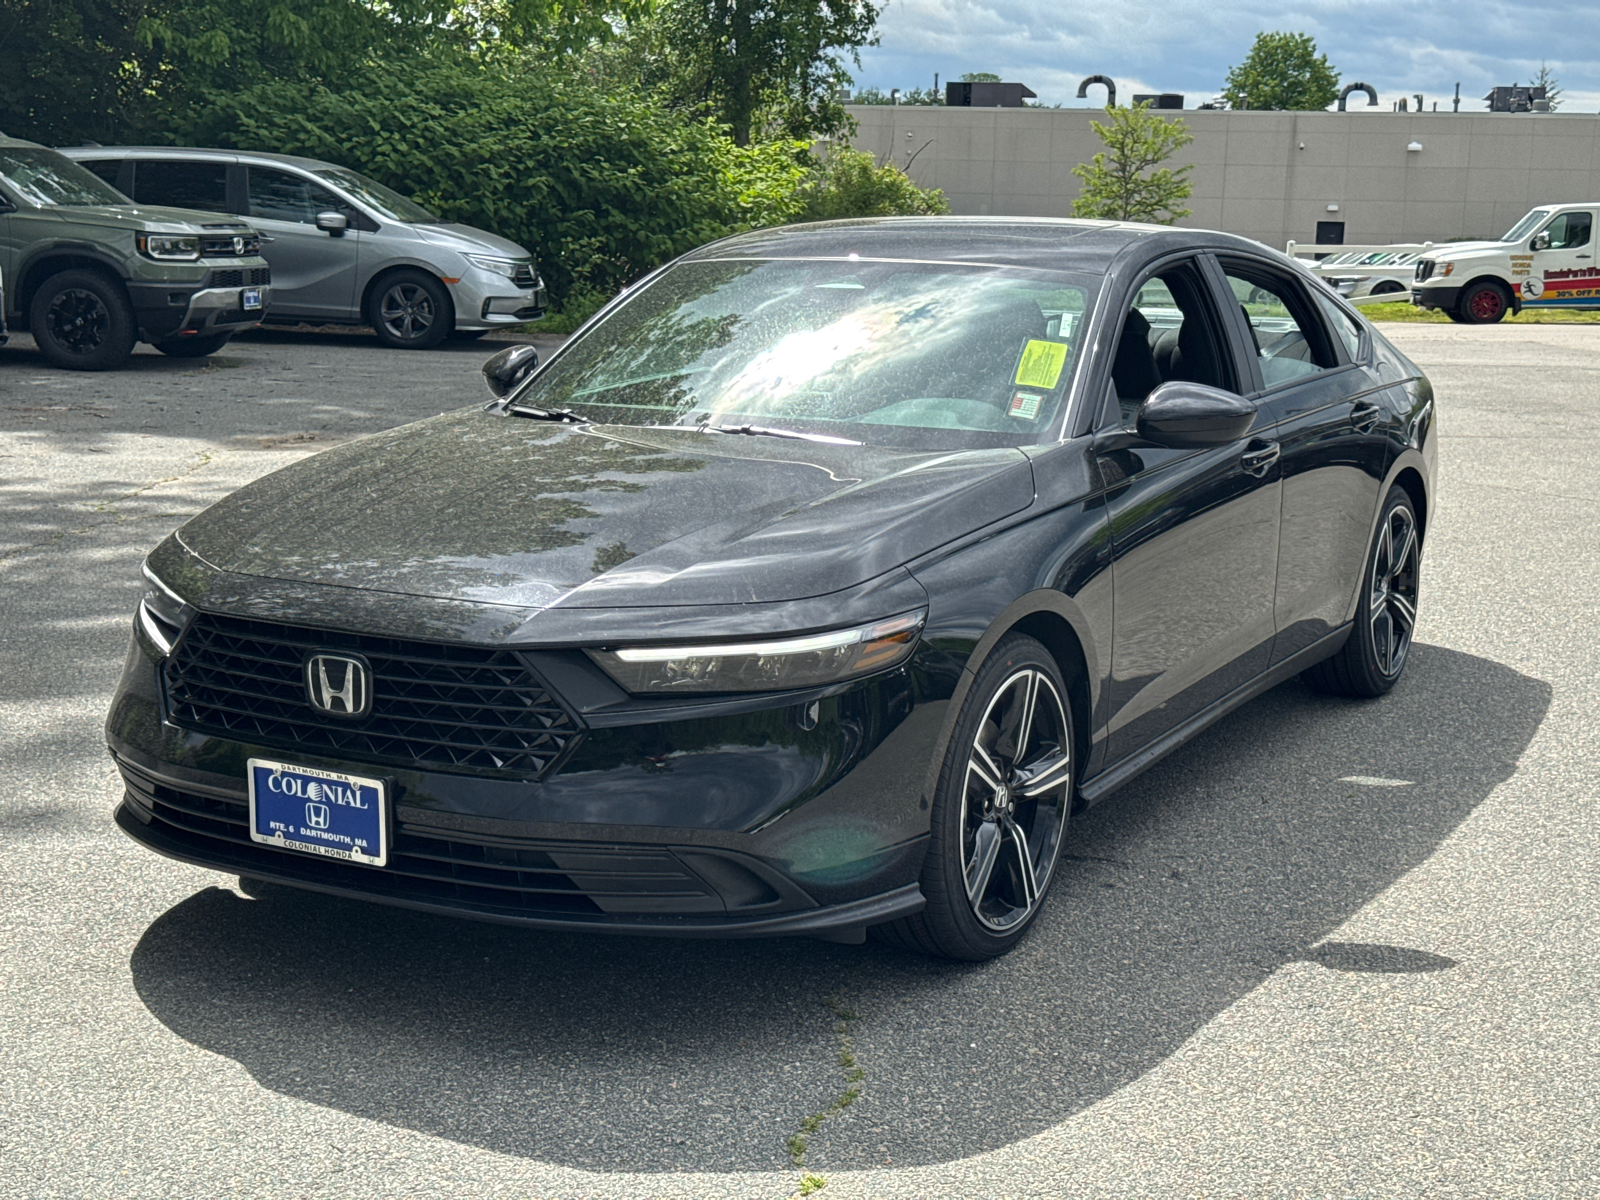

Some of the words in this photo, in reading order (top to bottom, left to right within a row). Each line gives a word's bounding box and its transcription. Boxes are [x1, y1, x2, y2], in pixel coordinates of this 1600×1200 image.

[1576, 289, 1593, 297] OFF
[336, 774, 350, 782] MA
[268, 774, 368, 809] COLONIAL
[269, 821, 288, 832] RTE.
[288, 825, 295, 833] 6
[300, 827, 353, 845] DARTMOUTH,
[354, 838, 368, 848] MA
[283, 840, 322, 854] COLONIAL
[324, 847, 353, 860] HONDA
